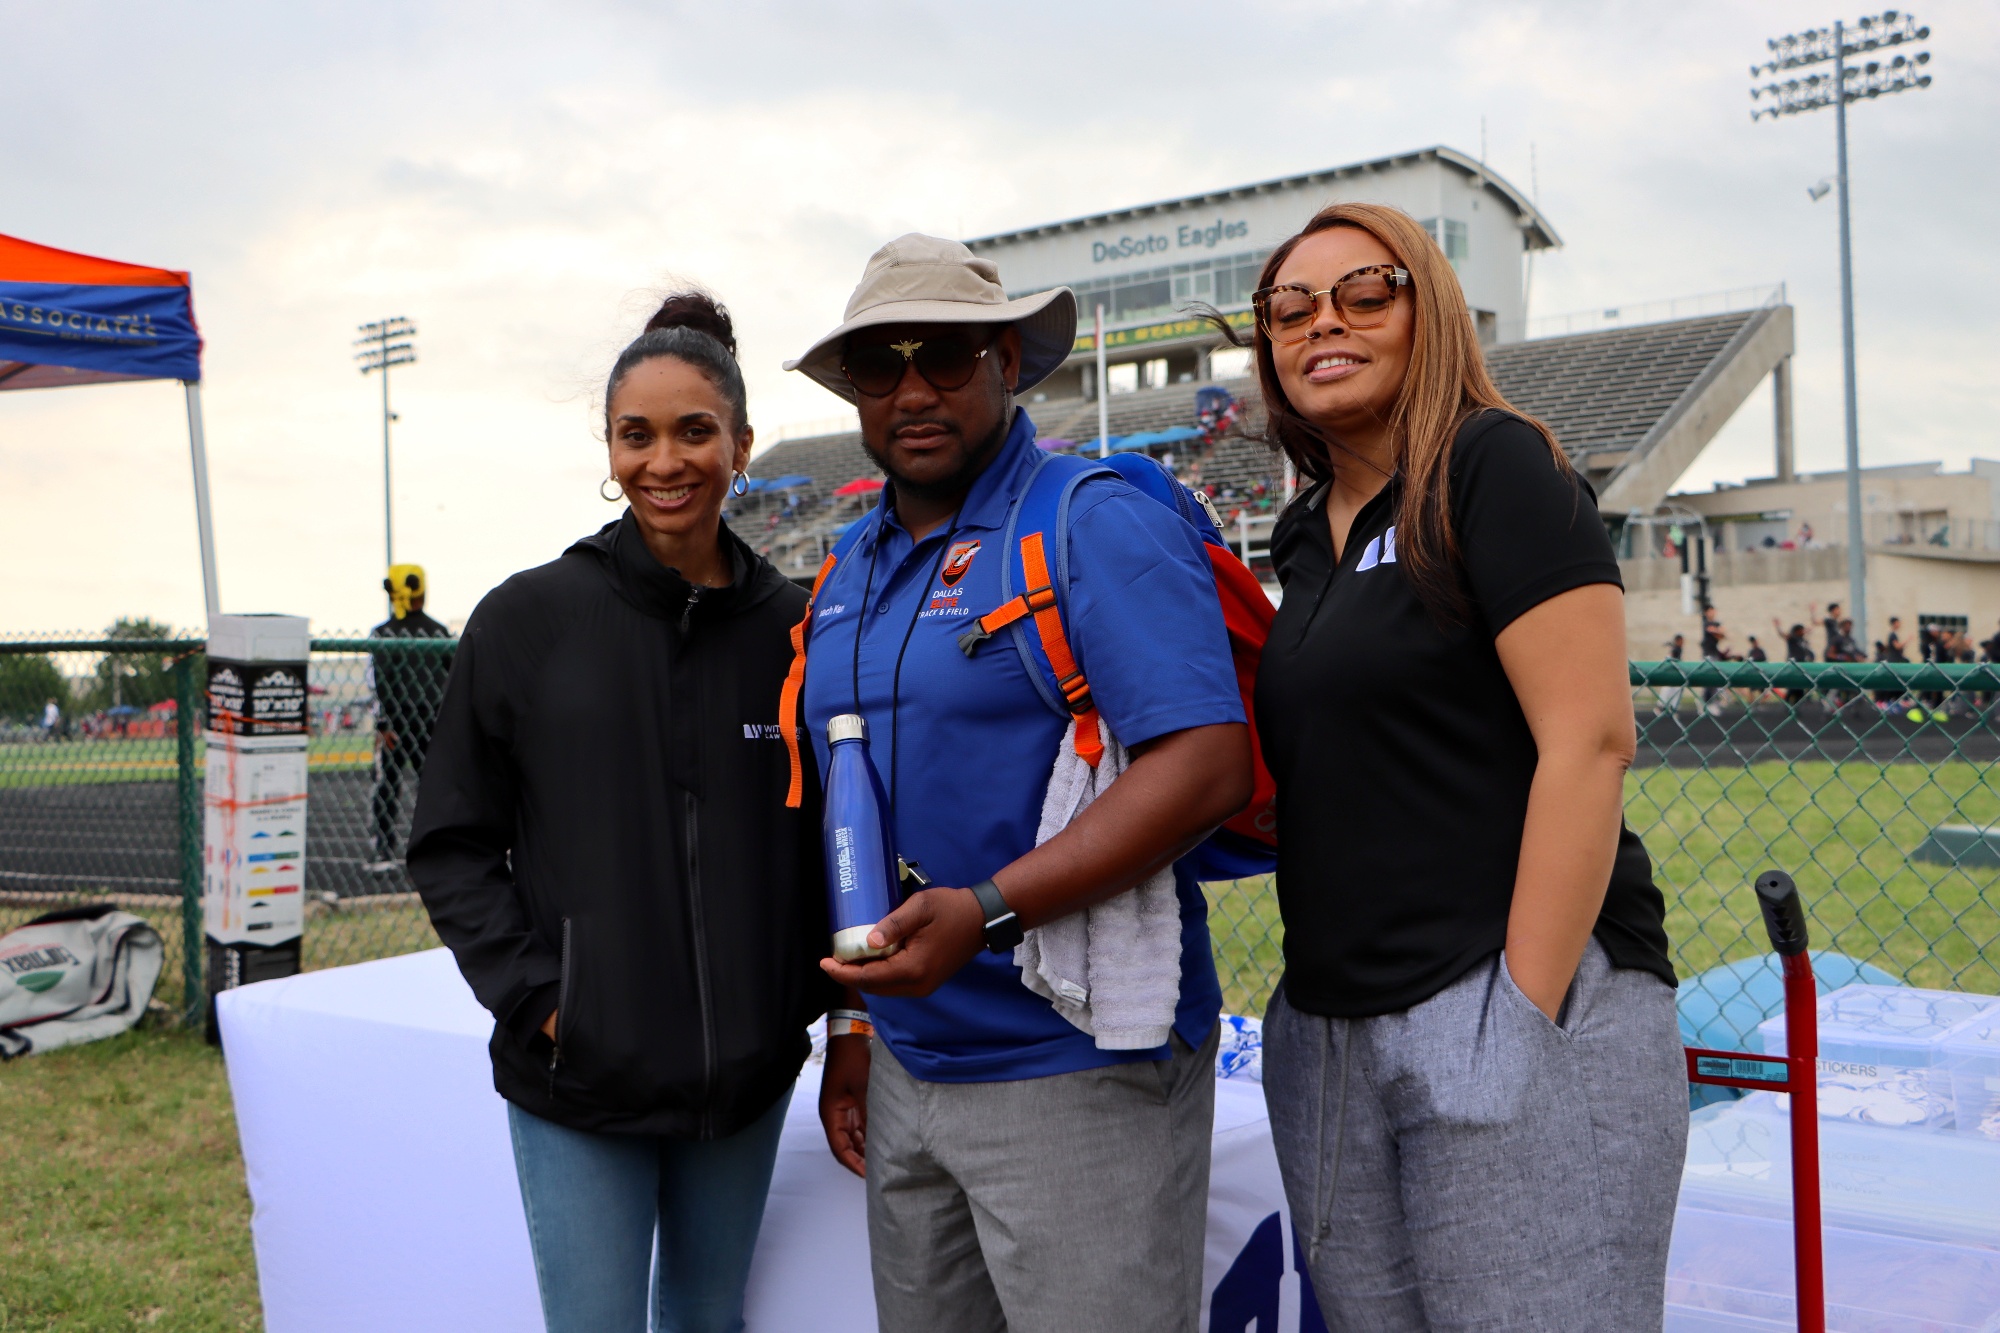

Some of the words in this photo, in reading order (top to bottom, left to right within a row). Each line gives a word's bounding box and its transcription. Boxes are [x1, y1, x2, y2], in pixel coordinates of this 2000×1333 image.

[1091, 234, 1169, 263] DeSoto
[1177, 218, 1249, 248] Eagles
[932, 587, 963, 599] DALLAS
[930, 597, 958, 608] ELITE
[917, 609, 938, 620] TRACK
[938, 608, 945, 616] &
[945, 607, 969, 616] FIELD
[835, 829, 843, 849] TRUCK
[840, 826, 849, 848] WRECK
